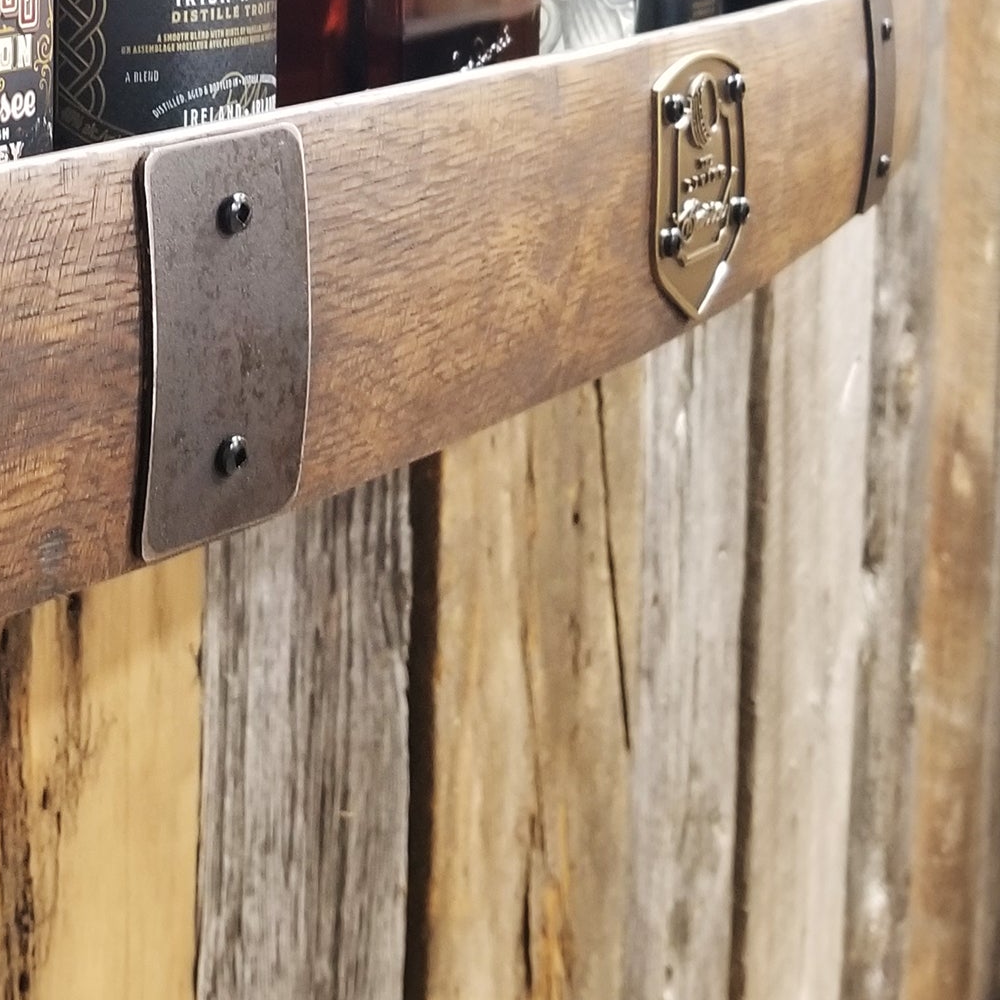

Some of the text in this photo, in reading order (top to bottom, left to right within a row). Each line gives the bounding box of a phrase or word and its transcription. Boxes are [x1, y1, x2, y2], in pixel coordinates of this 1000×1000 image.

[171, 3, 239, 24] DISTILLÉ
[156, 33, 162, 43] A
[163, 31, 189, 43] SMOOTH
[124, 70, 159, 83] A BLEND
